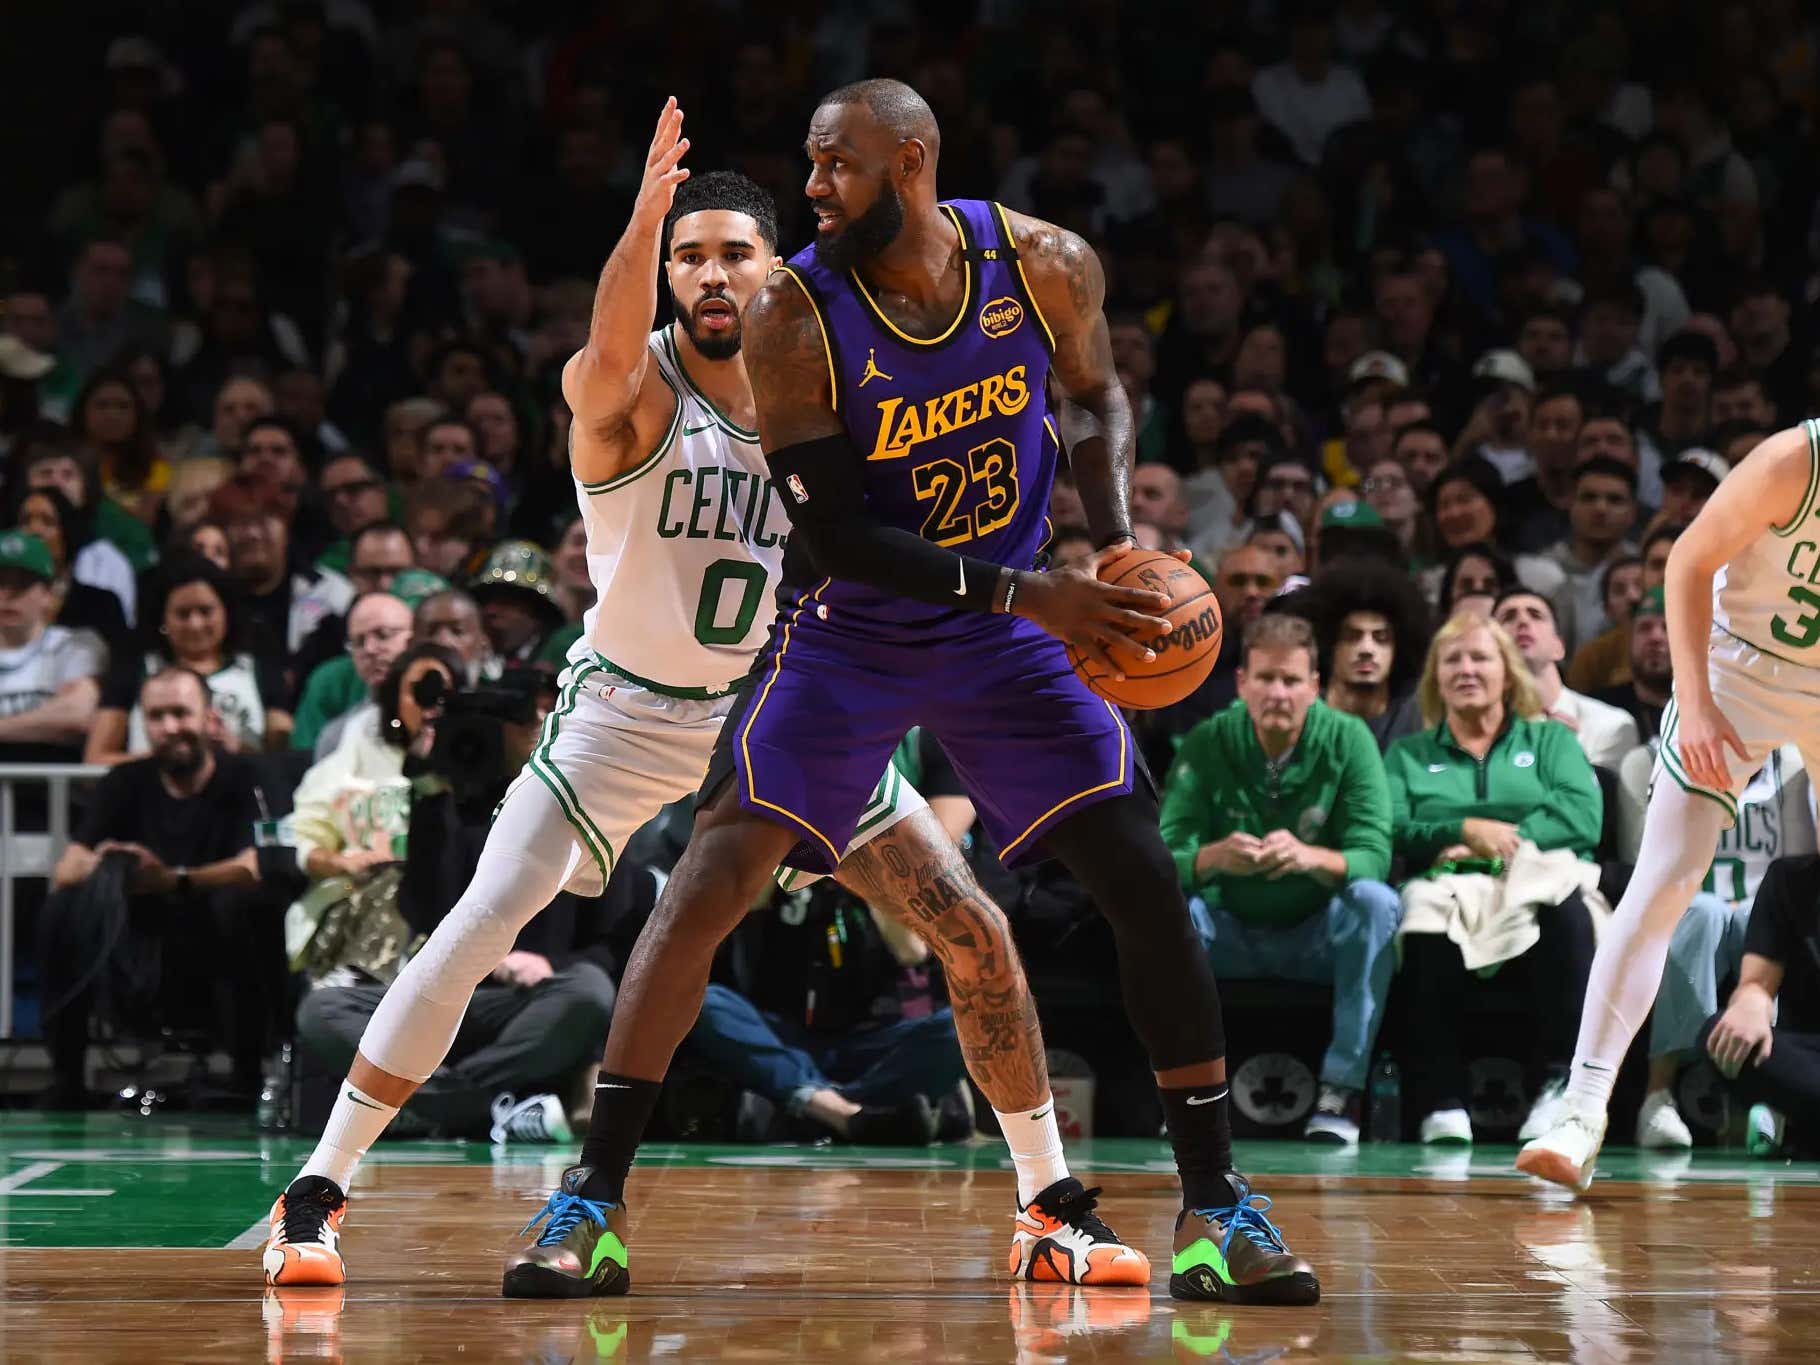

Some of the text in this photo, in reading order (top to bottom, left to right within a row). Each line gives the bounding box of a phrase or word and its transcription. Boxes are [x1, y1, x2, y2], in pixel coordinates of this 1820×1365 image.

[983, 249, 997, 260] 44
[982, 306, 1020, 328] bibigo
[866, 365, 1031, 461] LAKERS
[656, 466, 788, 548] CELTIC
[912, 437, 1020, 548] 23
[694, 558, 769, 645] 0
